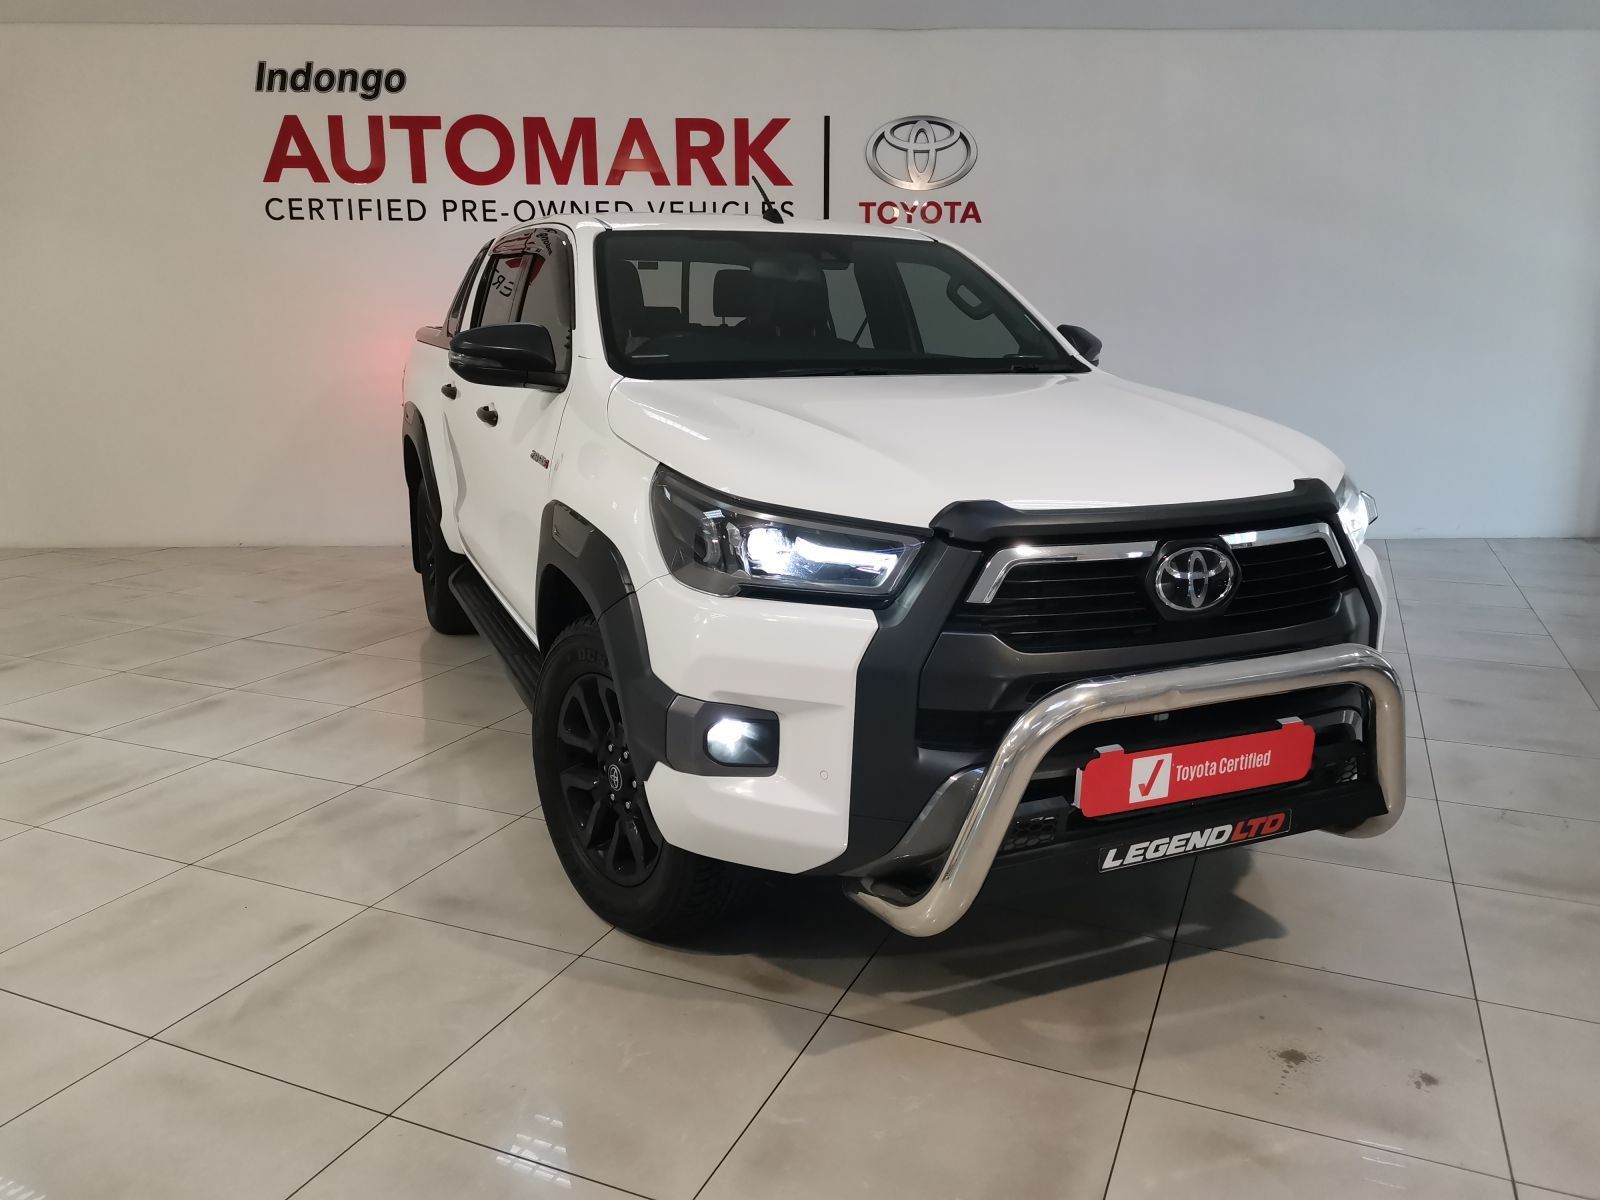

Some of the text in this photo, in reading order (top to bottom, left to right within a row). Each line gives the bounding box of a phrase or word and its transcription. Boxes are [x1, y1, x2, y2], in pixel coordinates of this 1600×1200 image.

[255, 61, 406, 100] Indongo
[263, 114, 793, 186] AUTOMARK
[265, 197, 427, 222] CERTIFIED
[443, 199, 633, 222] PRE-OWNED
[859, 201, 982, 224] TOYOTA
[1176, 750, 1271, 782] Toyota Certified
